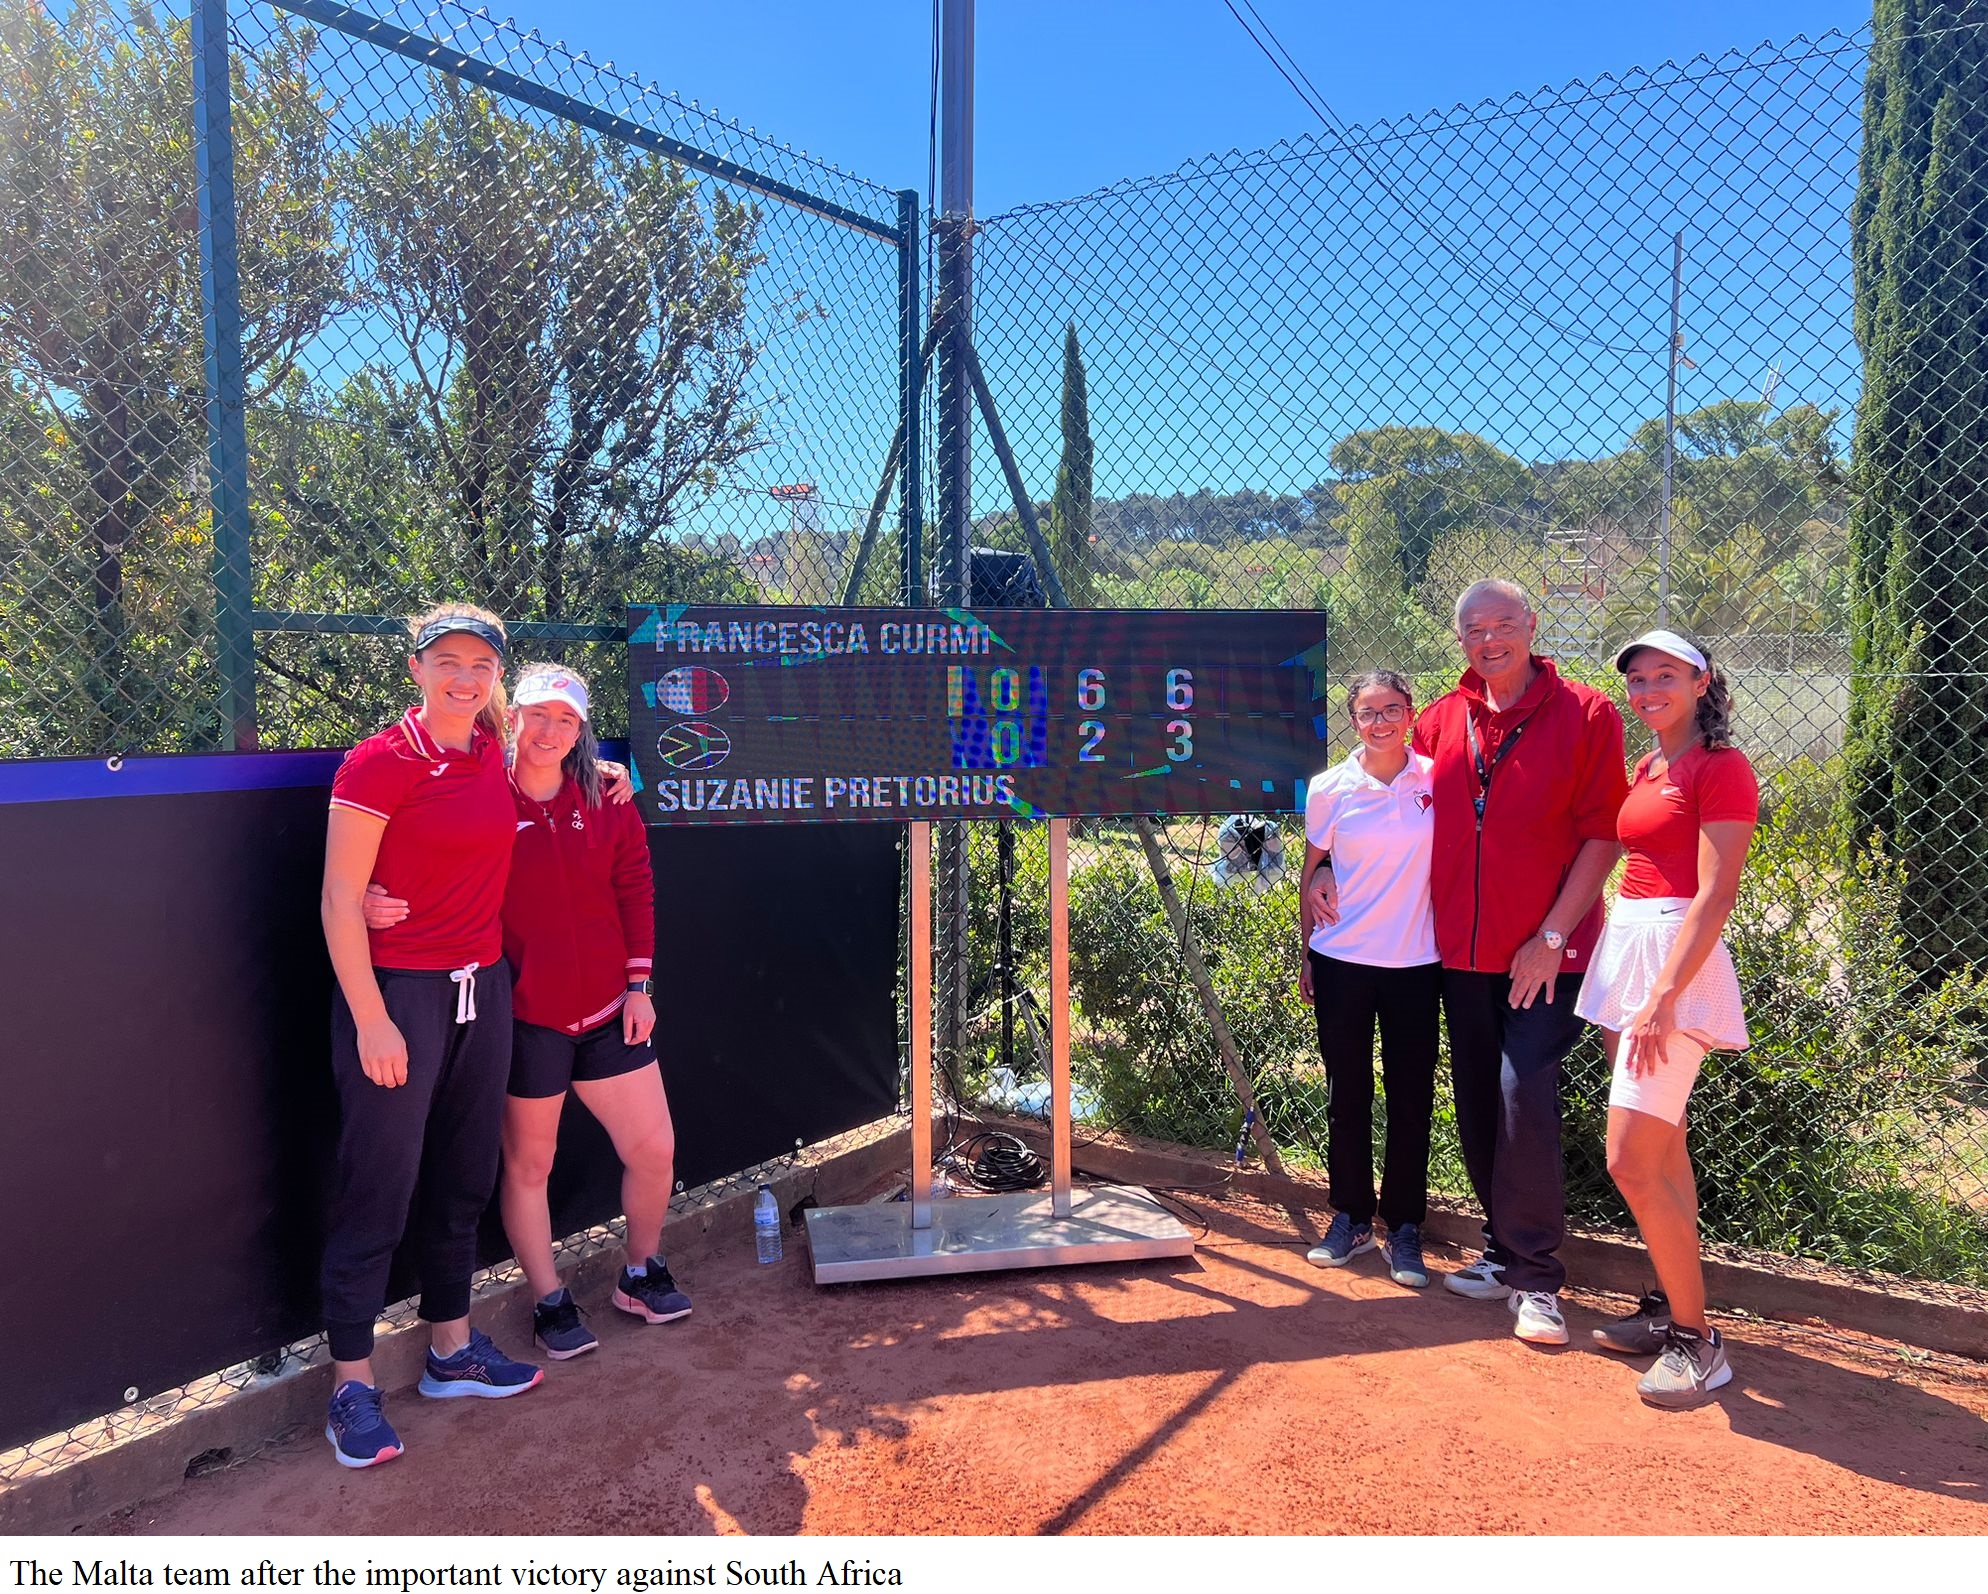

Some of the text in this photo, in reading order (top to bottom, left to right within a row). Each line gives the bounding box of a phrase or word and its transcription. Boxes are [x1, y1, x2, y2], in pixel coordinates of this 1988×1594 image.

[655, 620, 990, 655] FRANCESCA CURMI
[991, 668, 1194, 711] 0 6 6
[991, 720, 1194, 764] 0 2 3
[657, 775, 1015, 812] SUZANIE PRETORIUS
